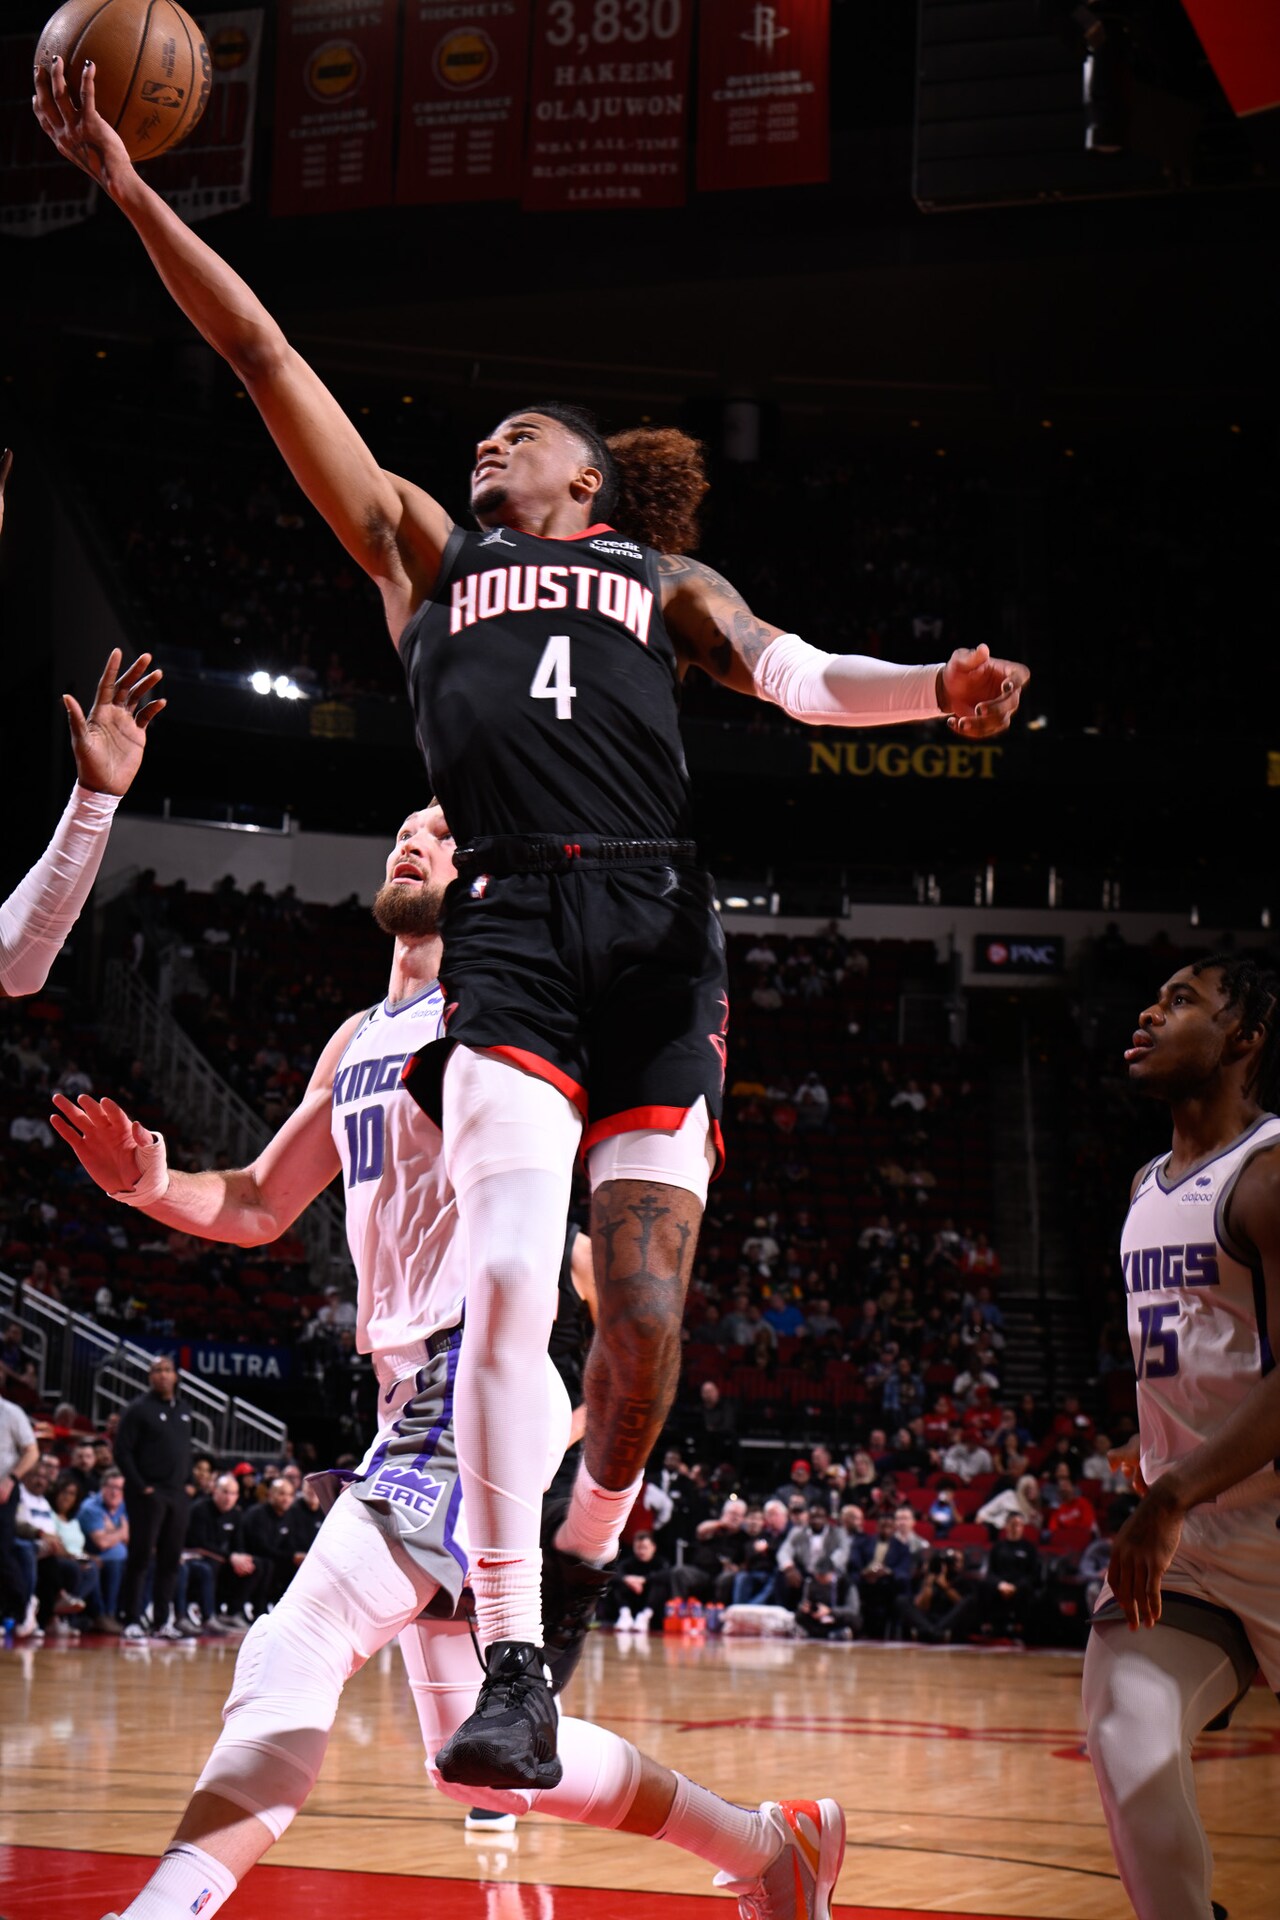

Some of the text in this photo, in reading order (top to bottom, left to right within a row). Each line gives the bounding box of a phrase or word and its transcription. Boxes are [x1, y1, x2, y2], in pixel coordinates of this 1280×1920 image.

[545, 0, 682, 54] 3,830
[554, 60, 674, 86] HAKEEM
[725, 70, 801, 88] DIVISION
[712, 81, 815, 101] CHAMPIONS
[535, 93, 684, 124] OLAJUWON
[593, 136, 680, 152] ALL-TIME
[532, 161, 679, 178] BLOCKED SHOTS
[567, 186, 643, 201] LEADER
[589, 542, 643, 560] karma
[592, 539, 641, 552] credit
[450, 565, 653, 646] HOUSTON
[530, 635, 577, 720] 4
[809, 741, 1003, 779] NUGGET
[1009, 943, 1057, 965] PNC
[344, 1104, 386, 1189] 10
[1181, 1191, 1214, 1203] dialpad
[1137, 1301, 1181, 1381] 15
[197, 1351, 282, 1380] ULTRA
[371, 1483, 434, 1516] SAC
